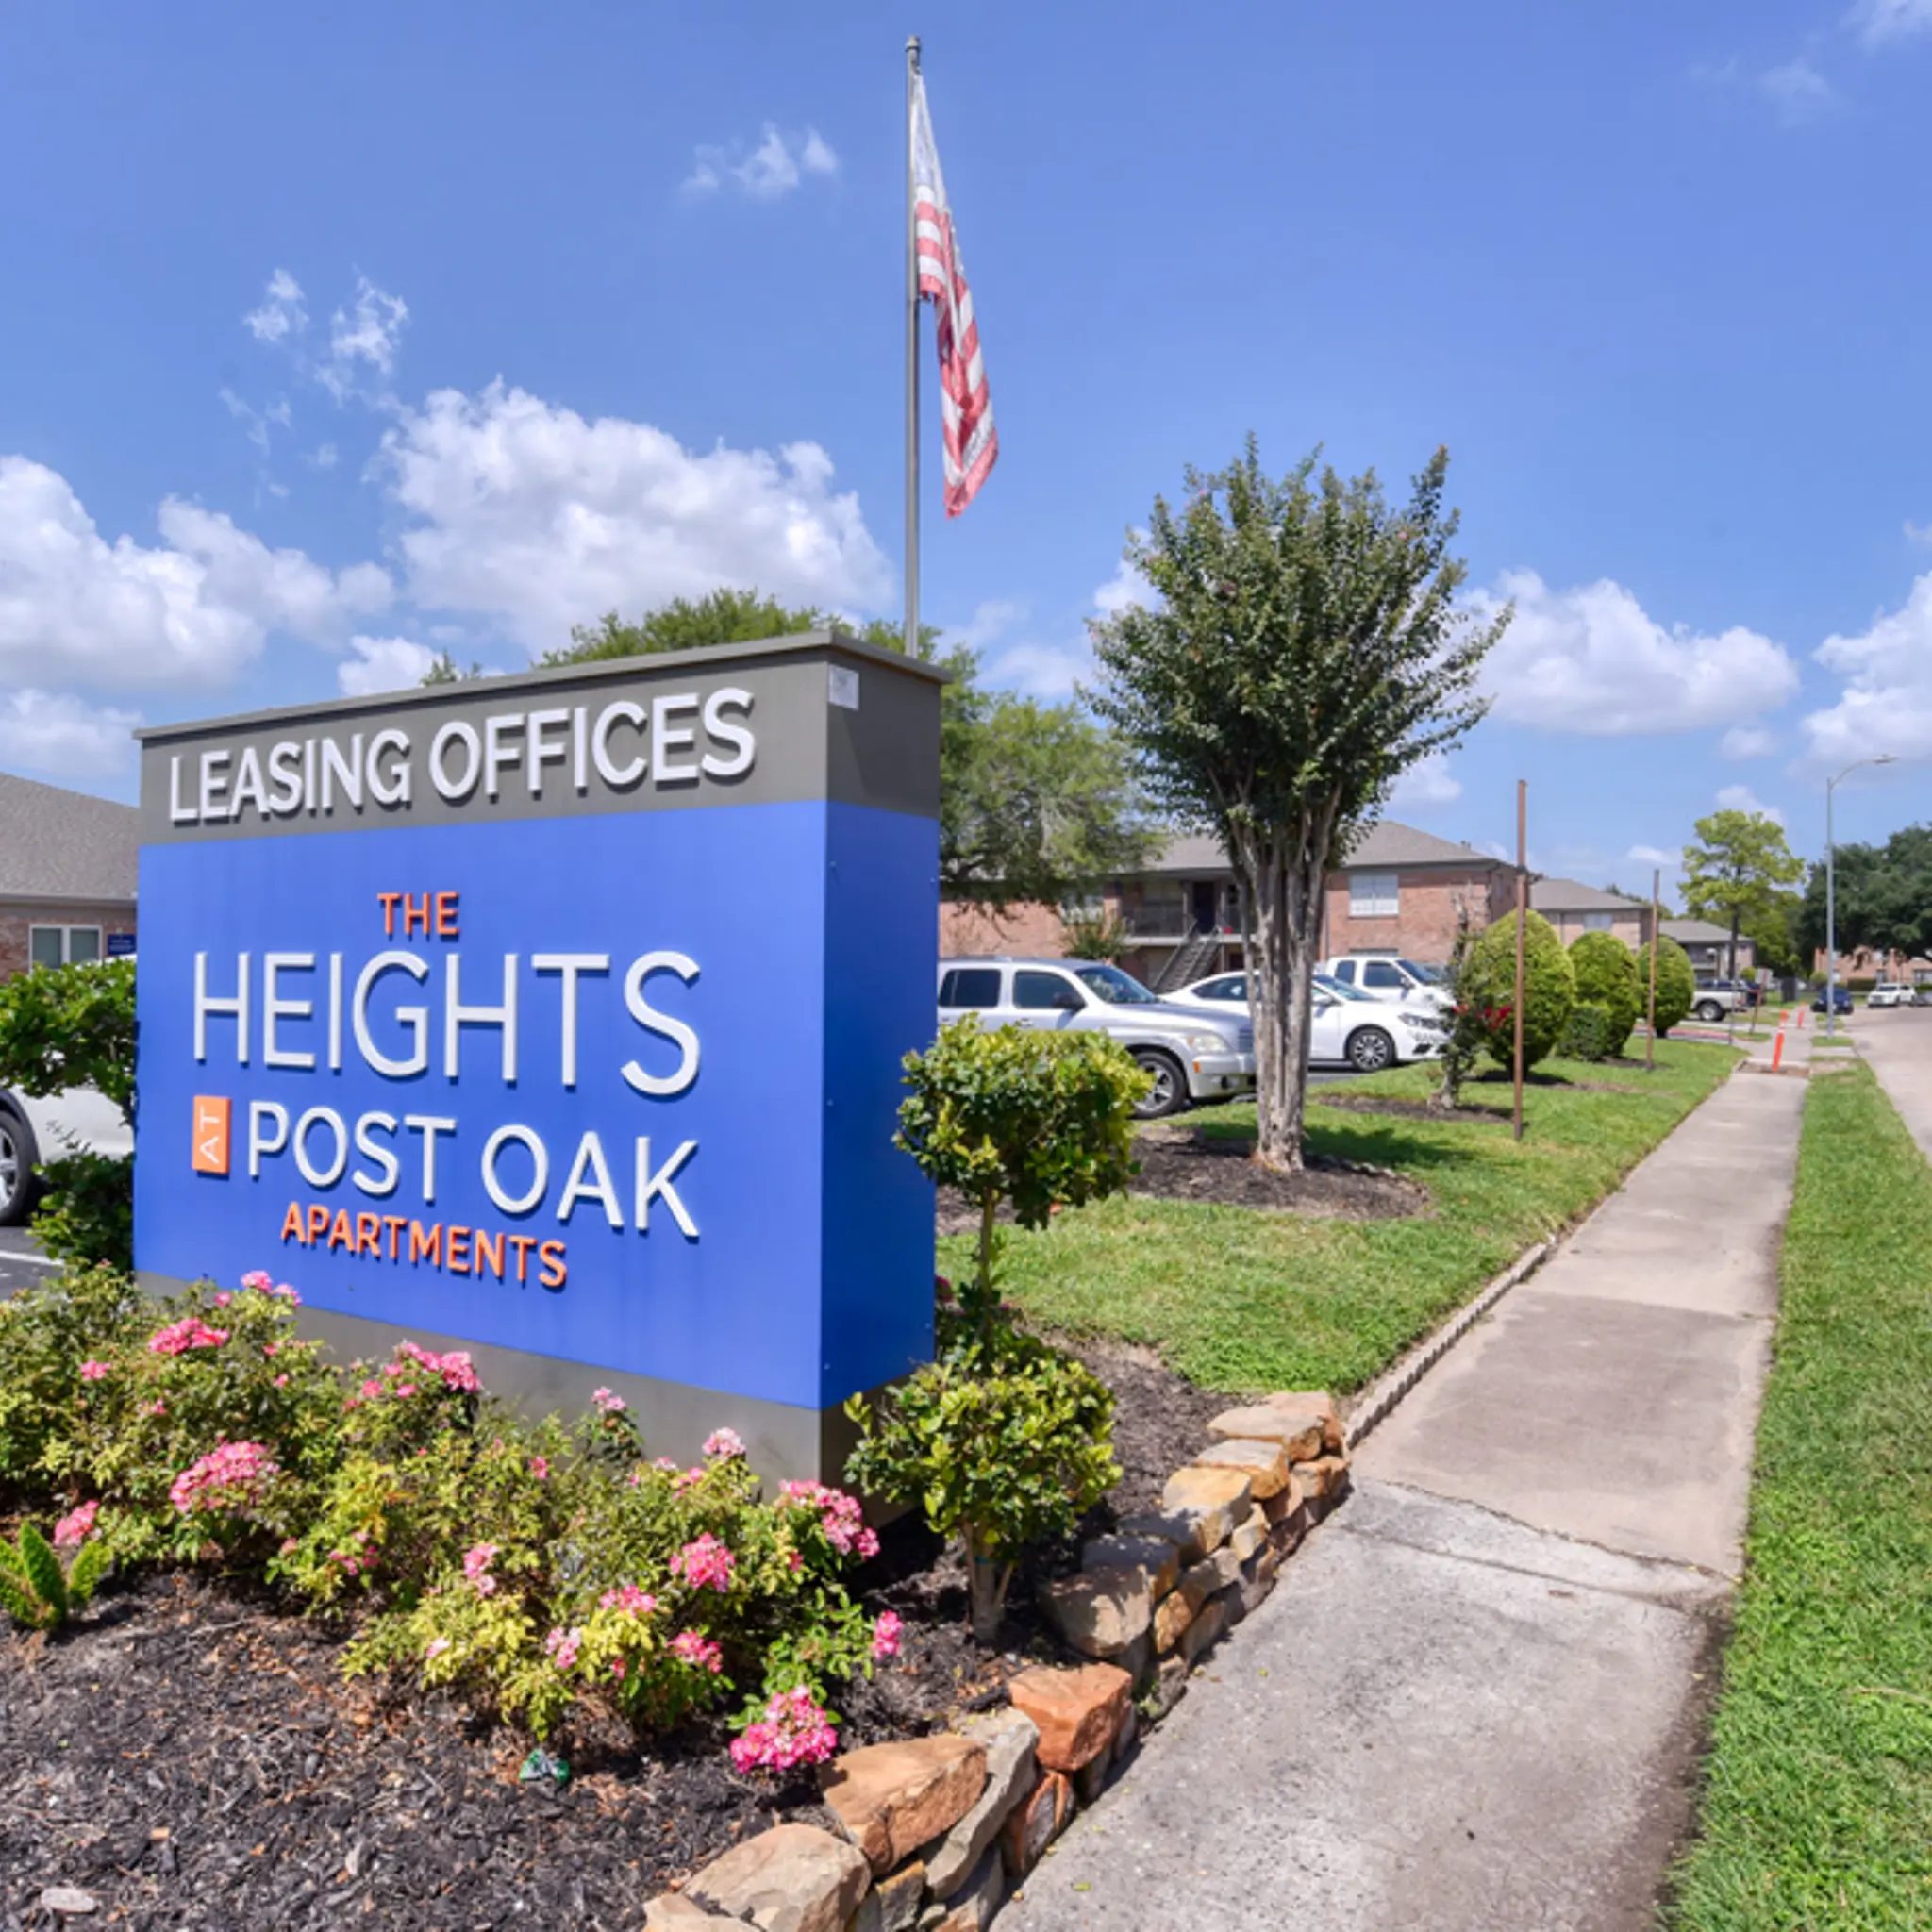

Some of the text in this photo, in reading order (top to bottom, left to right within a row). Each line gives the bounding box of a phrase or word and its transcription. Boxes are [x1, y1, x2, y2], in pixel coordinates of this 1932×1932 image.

[170, 687, 756, 823] LEASING OFFICES
[377, 891, 460, 939] THE
[192, 950, 702, 1096] HEIGHTS
[199, 1100, 702, 1240] AT POST OAK
[280, 1201, 568, 1288] APARTMENTS
